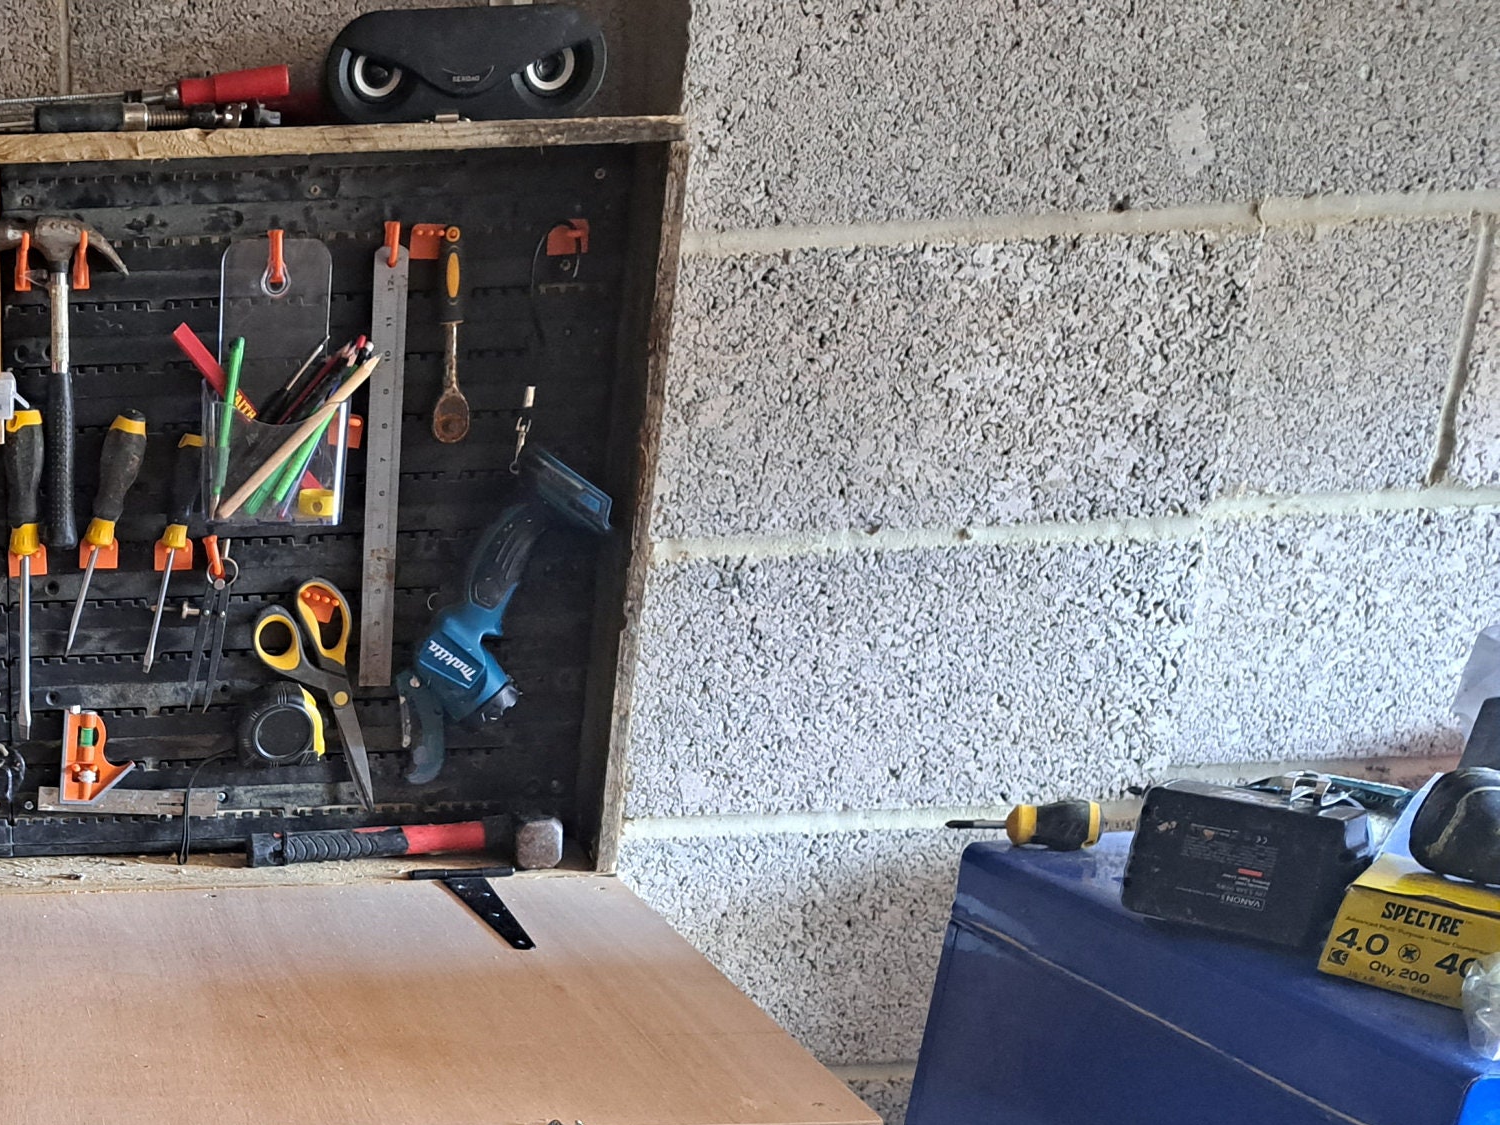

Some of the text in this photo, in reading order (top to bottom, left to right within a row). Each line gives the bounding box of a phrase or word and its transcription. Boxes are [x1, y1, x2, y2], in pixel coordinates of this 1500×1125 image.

[384, 350, 392, 362] 10
[428, 640, 476, 681] makita
[1225, 895, 1260, 907] VANON
[1381, 902, 1464, 936] SPECTRE
[1336, 928, 1389, 955] 4.0
[1369, 961, 1430, 984] Qty. 200
